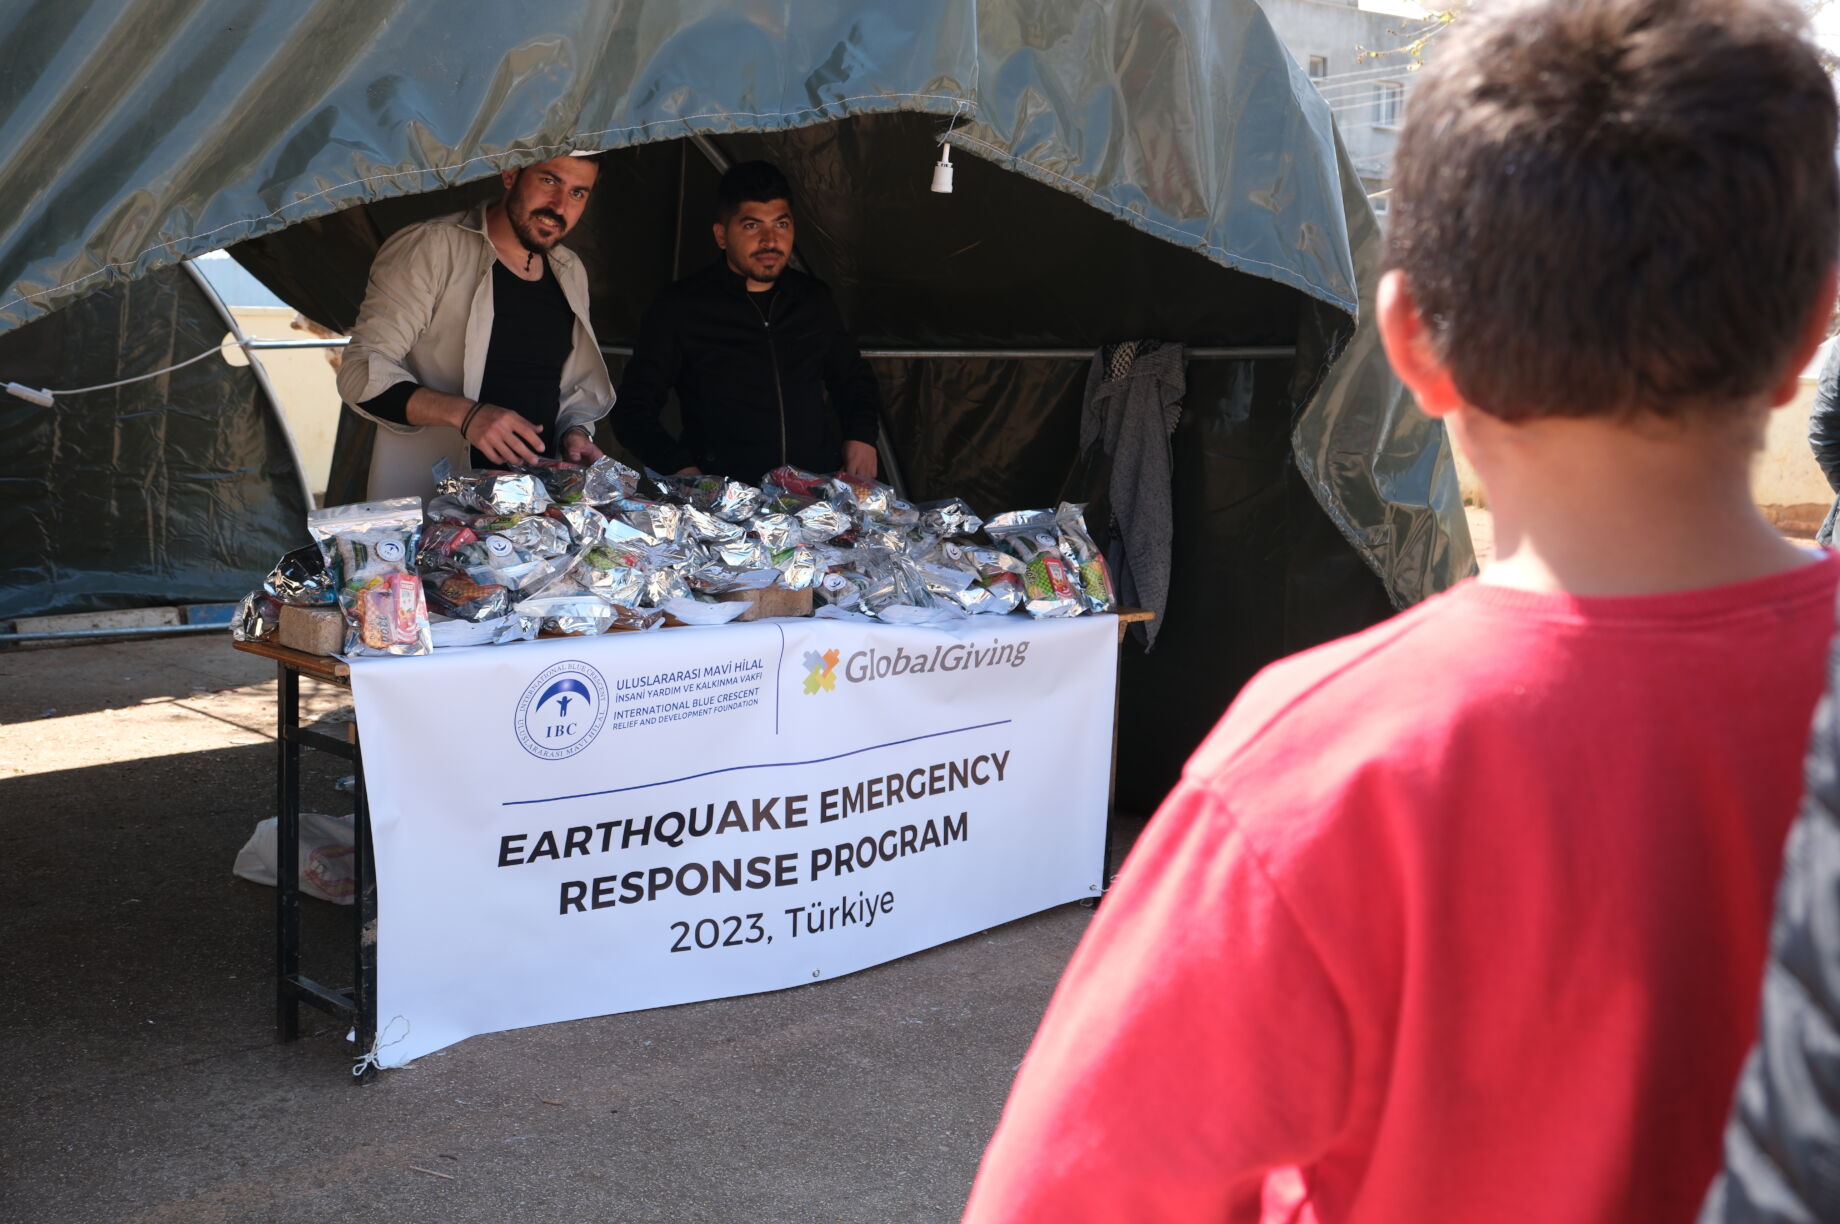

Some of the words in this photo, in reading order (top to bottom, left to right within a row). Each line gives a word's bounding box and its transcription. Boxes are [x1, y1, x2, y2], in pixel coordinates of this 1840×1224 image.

[617, 668, 701, 691] ULUSLARARASI
[703, 661, 732, 678] MAVİ
[734, 658, 764, 673] HİLAL
[845, 638, 1030, 683] GlobalGiving
[520, 664, 567, 712] INTERNATIONAL
[567, 663, 587, 672] BLUE
[586, 667, 606, 702] CRESCENT
[613, 700, 690, 720] INTERNATIONAL
[692, 696, 715, 708] BLUE
[717, 687, 760, 703] CRESCENT
[615, 689, 646, 703] İNSANİ
[648, 684, 681, 699] YARDIM
[683, 683, 694, 693] VE
[695, 677, 738, 691] KALKINMA
[740, 671, 762, 683] VAKFI
[545, 722, 577, 739] IBC
[612, 720, 639, 730] RELIEF
[640, 717, 657, 726] AND
[658, 707, 712, 723] DEVELOPMENT
[714, 698, 759, 713] FOUNDATION
[517, 719, 563, 758] ULUSLARARASI
[497, 793, 809, 868] EARTHQUAKE
[819, 750, 1010, 825] EMERGENCY
[558, 852, 799, 916] RESPONSE
[809, 811, 969, 882] PROGRAM
[669, 913, 774, 954] 2023,
[785, 888, 895, 939] Türkiye
